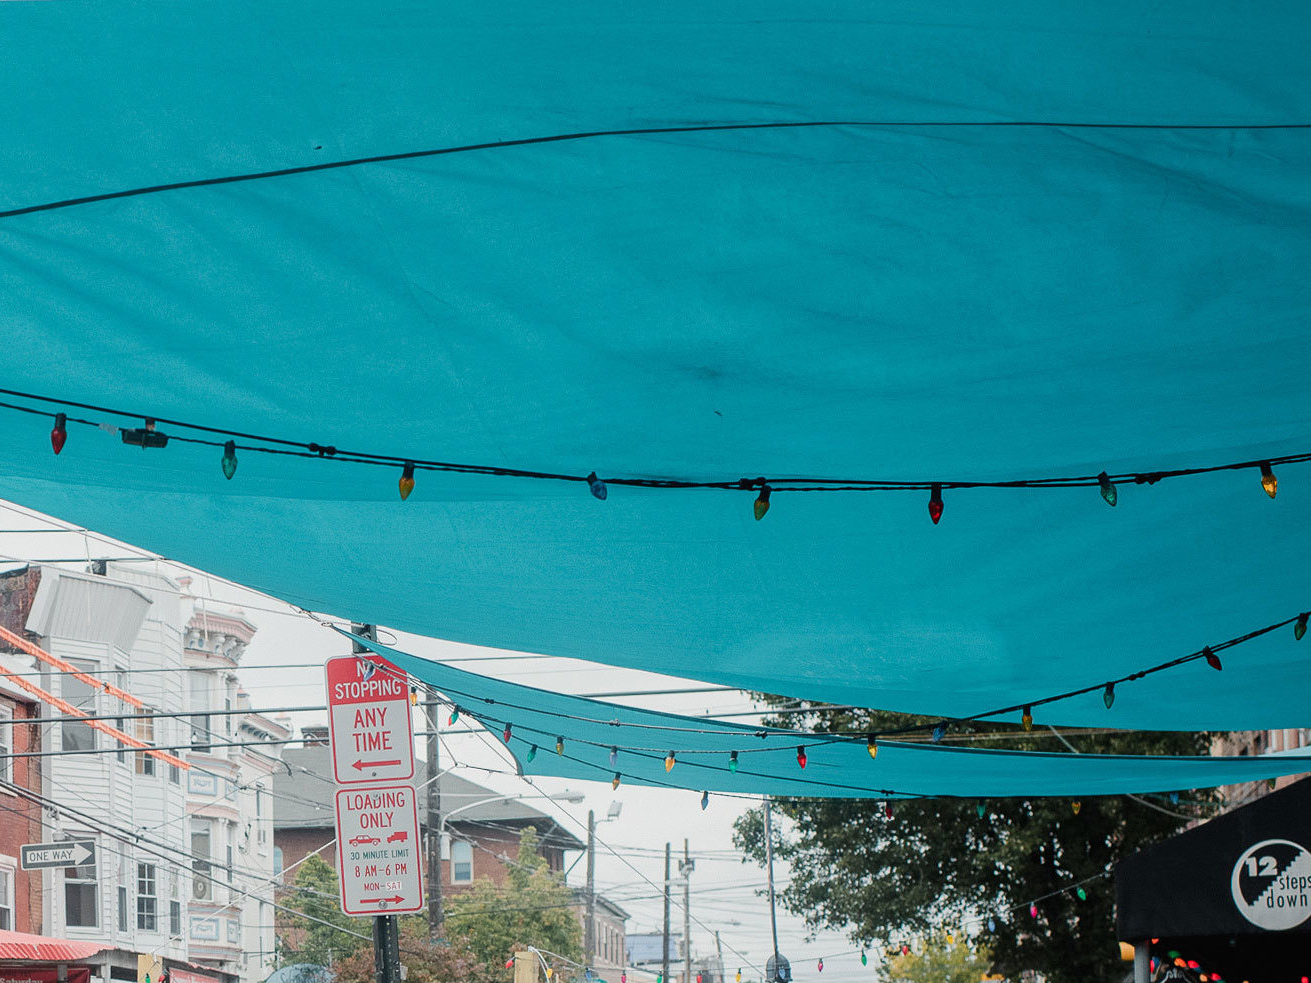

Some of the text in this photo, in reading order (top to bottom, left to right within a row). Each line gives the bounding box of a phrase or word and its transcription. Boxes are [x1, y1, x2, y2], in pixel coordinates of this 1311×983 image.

[335, 679, 402, 700] STOPPING
[353, 707, 388, 729] ANY
[352, 731, 393, 753] TIME
[346, 791, 406, 811] LOADING
[360, 811, 394, 829] ONLY
[29, 850, 73, 862] ONE WAY
[350, 848, 409, 861] 30 MINUTE LIMIT
[355, 865, 361, 878] 8
[395, 863, 408, 876] PM
[1245, 855, 1278, 877] 12
[1279, 875, 1311, 893] steps
[1267, 888, 1308, 908] down
